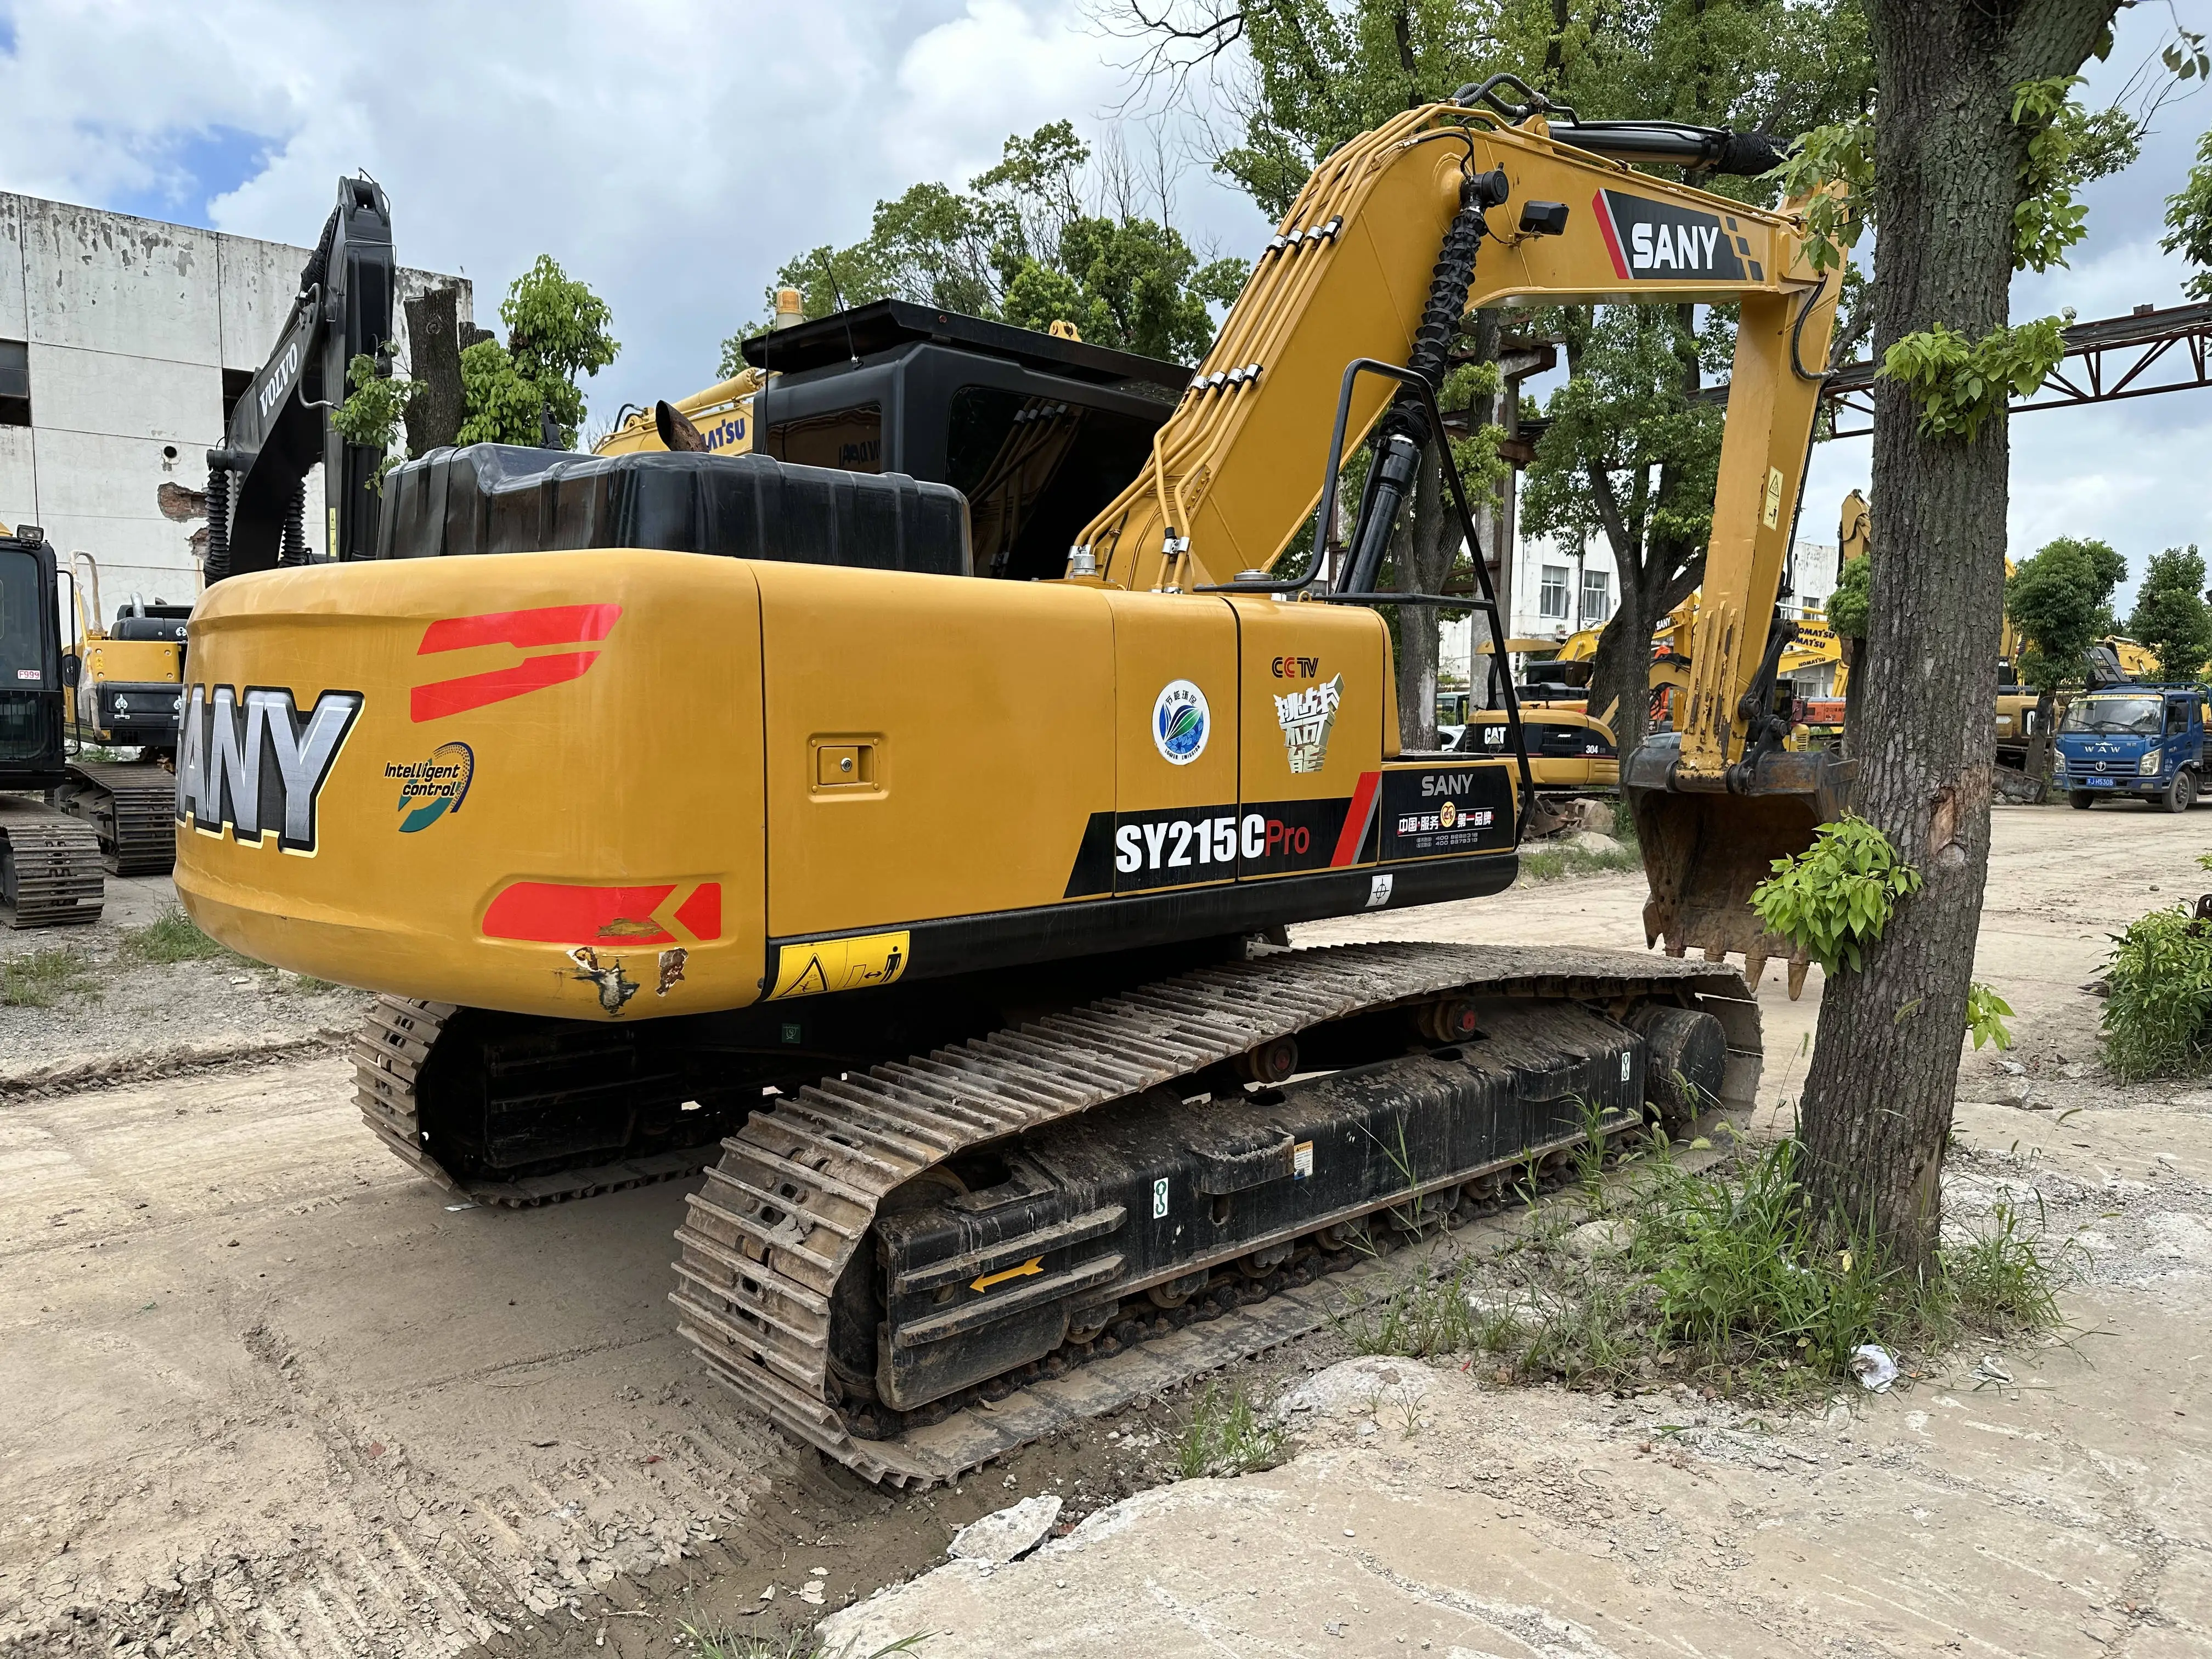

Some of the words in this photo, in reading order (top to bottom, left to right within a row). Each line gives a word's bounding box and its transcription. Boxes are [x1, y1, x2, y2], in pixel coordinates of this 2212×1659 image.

[1632, 222, 1719, 269] SANY
[259, 342, 298, 417] VOLVO
[1656, 617, 1671, 631] SANY
[1799, 628, 1835, 639] OMATSU
[1795, 637, 1826, 648] MATSU
[1272, 656, 1319, 679] CCTV
[1798, 657, 1826, 667] KOMATSU
[19, 670, 40, 679] F999
[1484, 727, 1506, 744] CAT
[1585, 744, 1599, 754] 304
[176, 684, 364, 857] ANY
[384, 762, 461, 782] Intelligent
[402, 781, 457, 796] control
[1421, 774, 1474, 797] SANY
[1457, 811, 1492, 828] 第一品牌
